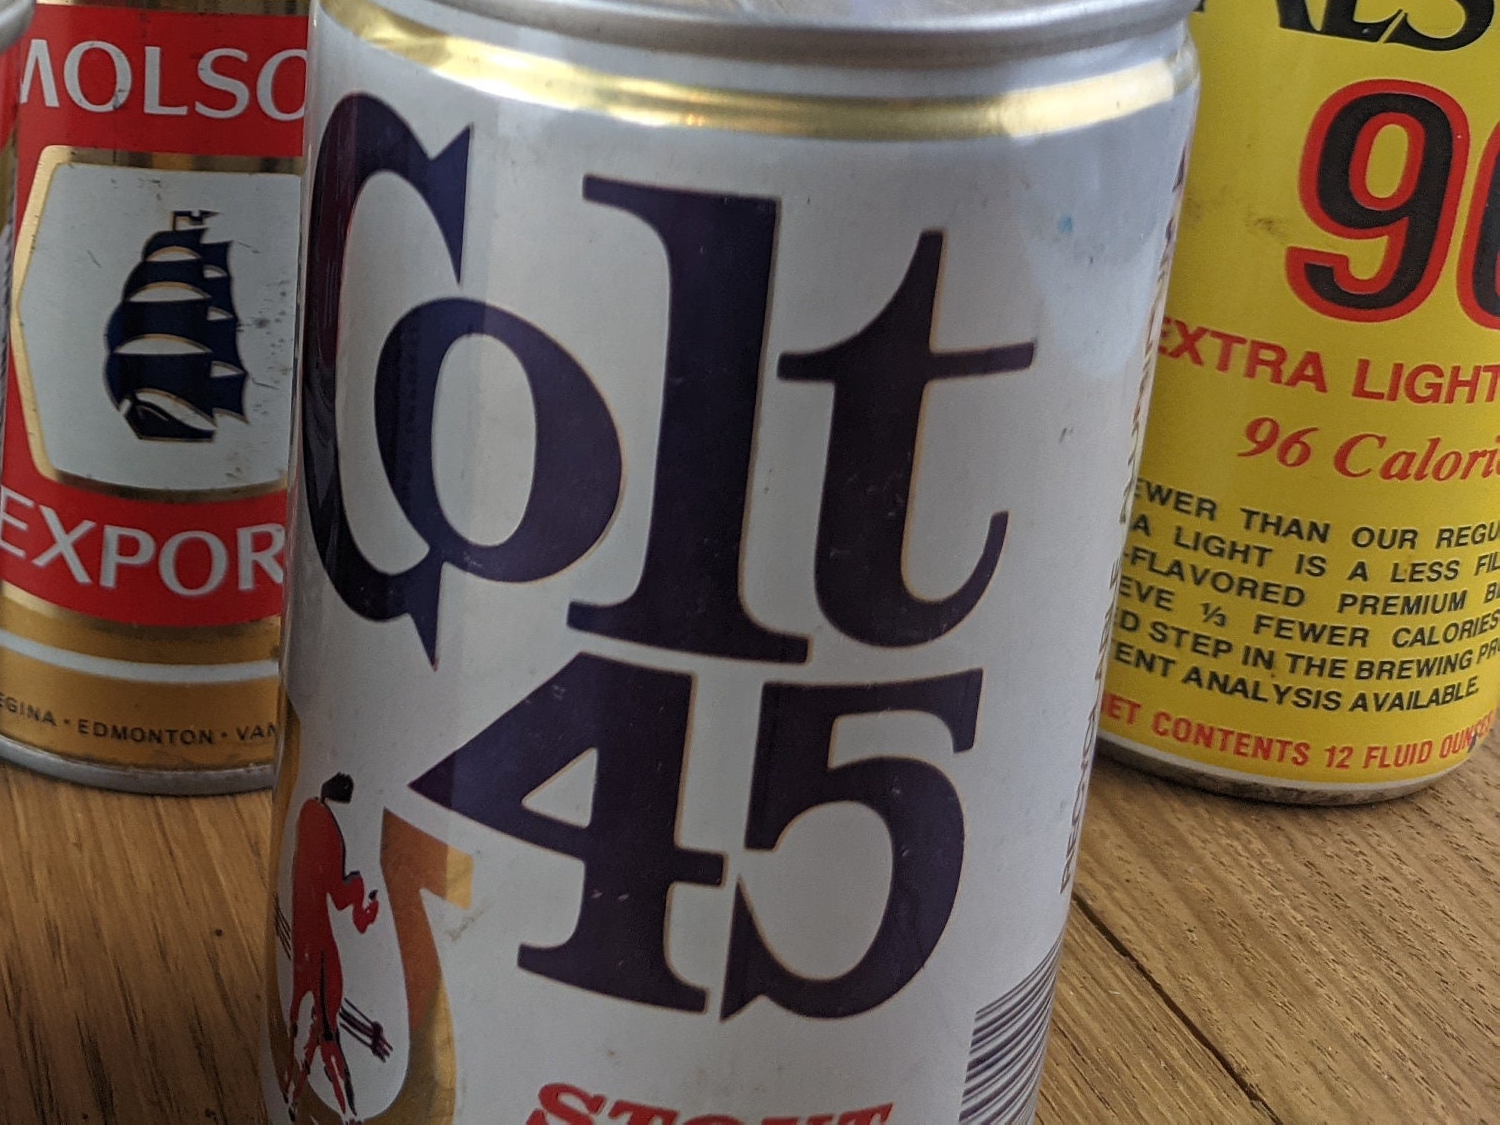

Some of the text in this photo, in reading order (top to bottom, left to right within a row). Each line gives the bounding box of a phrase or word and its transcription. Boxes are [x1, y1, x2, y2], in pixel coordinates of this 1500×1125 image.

[1285, 78, 1500, 330] 9
[301, 92, 1038, 672] Colt
[1239, 417, 1500, 482] 96 Calori
[1174, 526, 1273, 568] LIGHT
[1295, 553, 1327, 577] IS
[1347, 561, 1368, 582] A
[1391, 558, 1461, 583] LESS
[1240, 506, 1331, 544] THAN
[1352, 526, 1419, 550] OUR
[1252, 613, 1371, 648] FEWER
[1337, 589, 1468, 616] PREMIUM
[1149, 620, 1233, 659] STEP
[1242, 645, 1276, 671] IN
[1286, 652, 1348, 679] THE
[1355, 648, 1474, 681] BREWING
[1180, 665, 1342, 711] ANALYSIS
[77, 718, 213, 745] EDMONTON
[1151, 710, 1311, 767] CONTENTS
[1325, 745, 1354, 769] 12
[1362, 739, 1434, 770] FLUID
[408, 649, 986, 1022] 45
